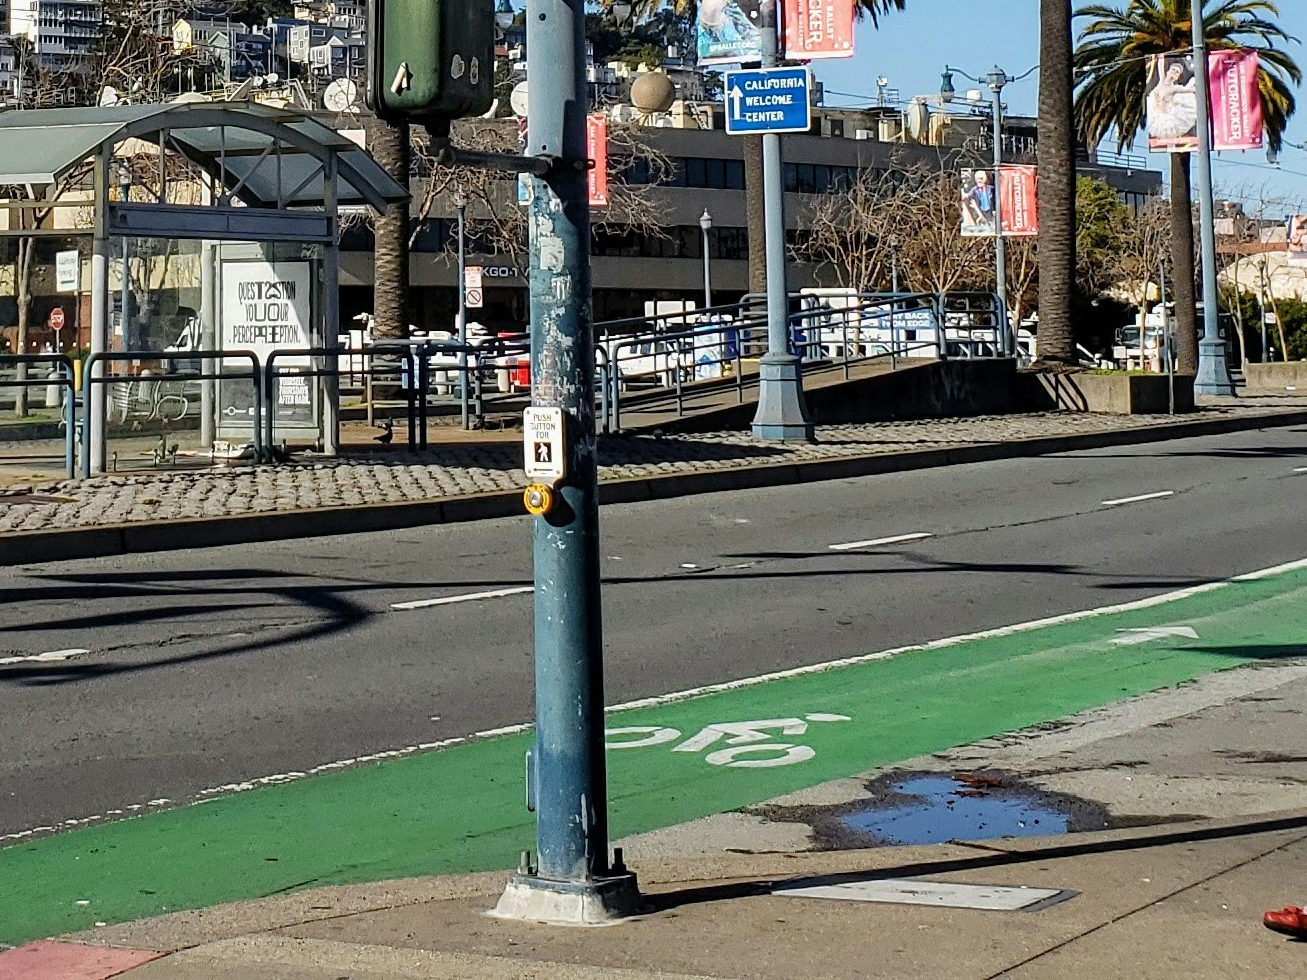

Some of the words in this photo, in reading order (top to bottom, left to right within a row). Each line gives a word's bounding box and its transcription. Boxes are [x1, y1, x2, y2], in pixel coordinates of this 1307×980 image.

[745, 78, 804, 90] CALIFORNIA
[746, 95, 793, 106] WELCOME
[746, 111, 784, 122] CENTER
[534, 414, 551, 422] PUSH
[536, 431, 549, 439] FOR
